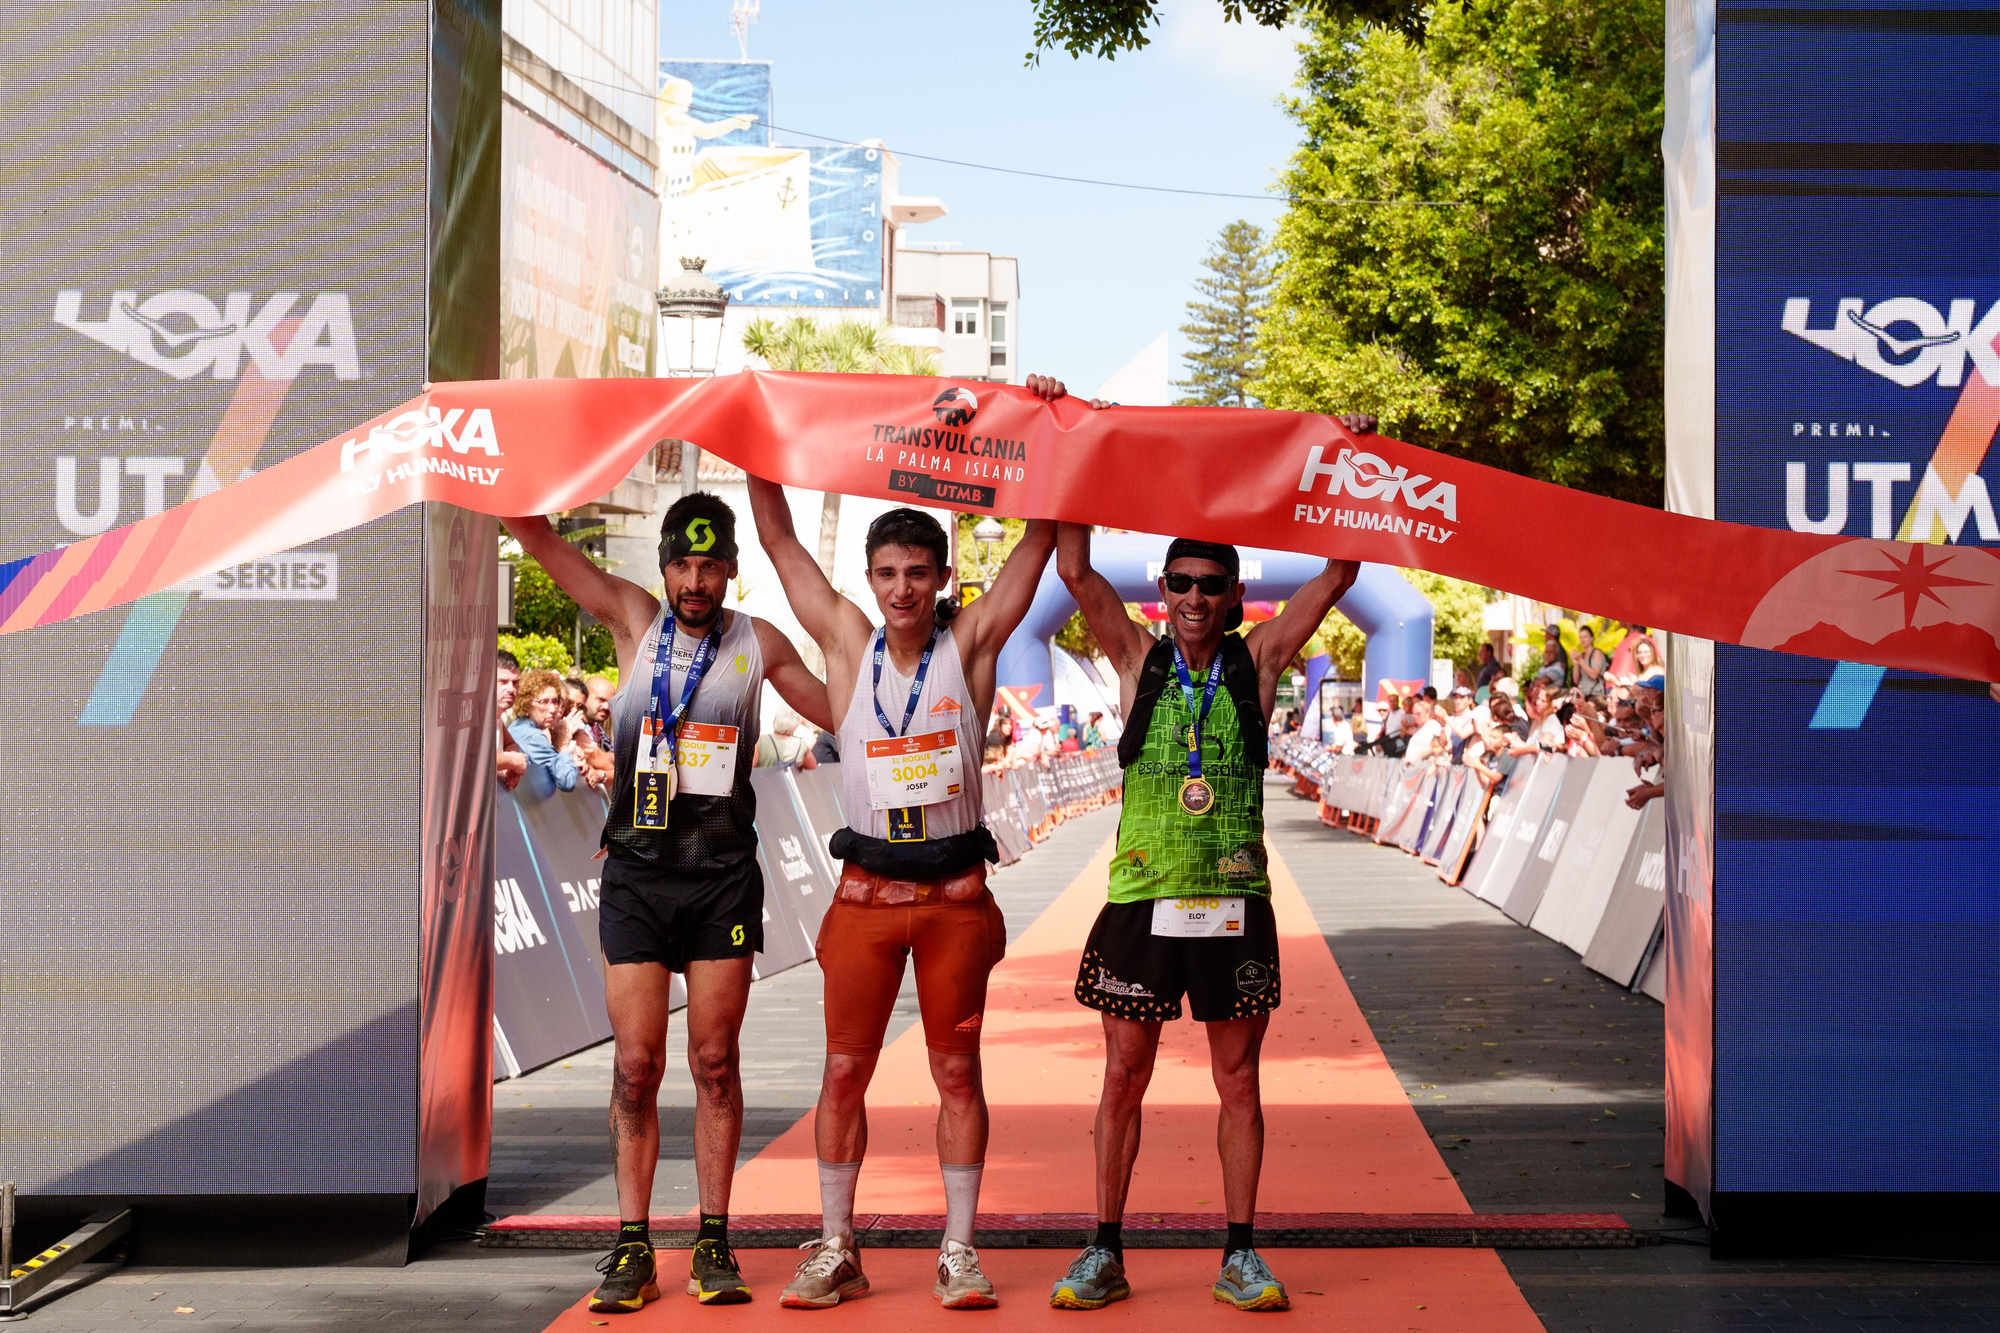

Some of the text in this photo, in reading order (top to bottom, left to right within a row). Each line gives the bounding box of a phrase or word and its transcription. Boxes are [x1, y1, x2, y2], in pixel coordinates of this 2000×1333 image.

[53, 289, 360, 380] HOKA
[64, 416, 164, 430] PREMI
[340, 405, 504, 474] HOKA
[872, 424, 1027, 462] TRANSVULCANIA
[345, 457, 501, 496] FLY HUMAN FLY
[866, 446, 1025, 482] LA PALMA ISLAND
[898, 474, 982, 503] BY UTMB
[1298, 445, 1457, 523] HOKA
[1294, 504, 1454, 544] FLY HUMAN FLY
[216, 562, 328, 589] SERIES
[1209, 652, 1223, 681] FINISHER
[892, 762, 939, 782] 3004
[902, 753, 931, 763] ROQUE
[906, 781, 928, 791] JOSEP
[646, 793, 658, 810] 2
[901, 807, 909, 823] 1
[494, 877, 547, 955] OKA
